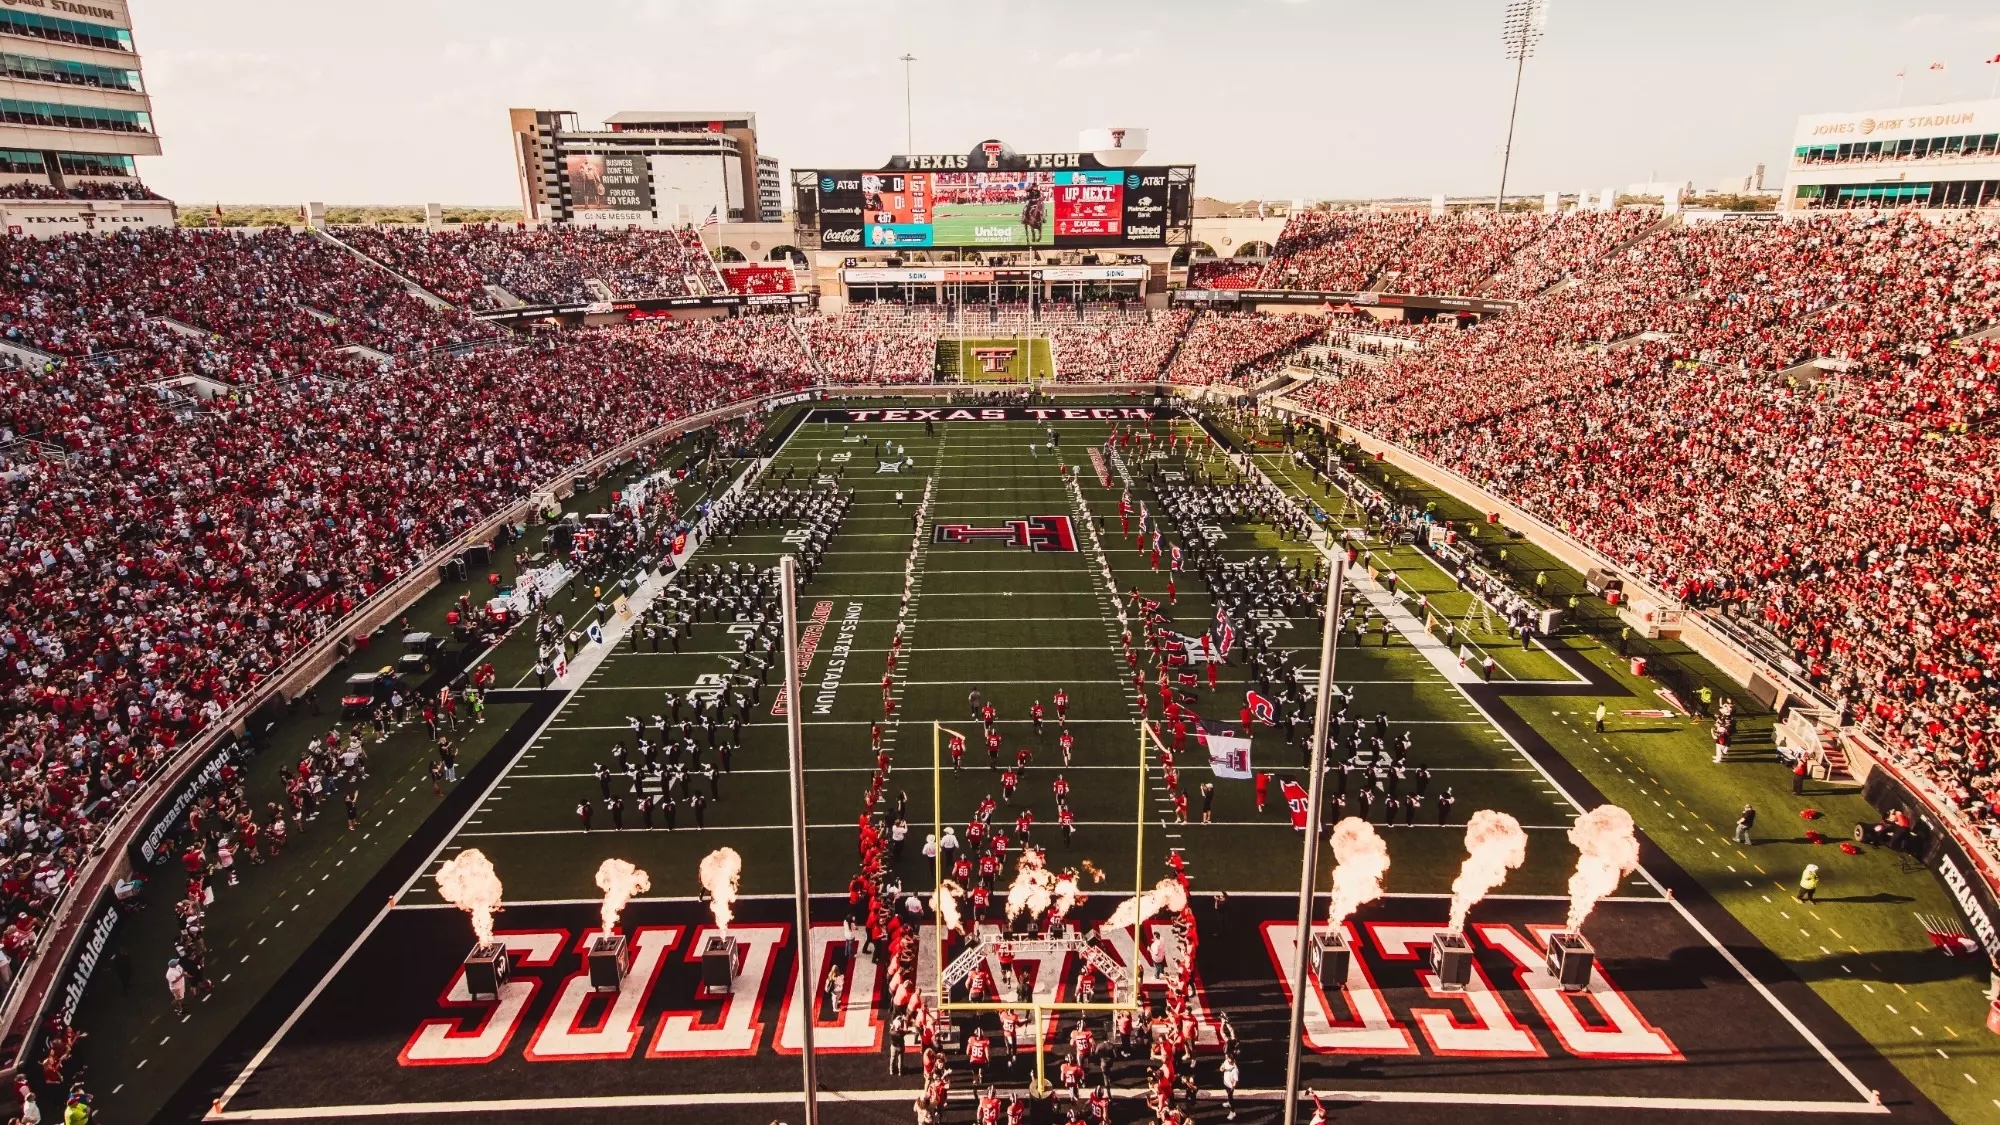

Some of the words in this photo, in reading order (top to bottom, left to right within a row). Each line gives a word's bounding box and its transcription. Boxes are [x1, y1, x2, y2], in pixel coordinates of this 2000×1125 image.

[51, 0, 115, 20] STADIUM
[1812, 122, 1855, 136] JONES
[1876, 119, 1904, 131] AT&T
[1908, 112, 1975, 129] STADIUM
[605, 159, 633, 167] BUSINESS
[906, 155, 969, 170] TEXAS
[1026, 153, 1081, 168] TECH
[606, 167, 622, 175] DONE
[622, 167, 634, 175] THE
[602, 175, 623, 184] RIGHT
[624, 175, 640, 184] WAY
[1141, 176, 1166, 186] AT&T
[836, 180, 860, 190] AT&T
[1064, 187, 1080, 200] UP
[1082, 186, 1113, 200] NEXT
[607, 197, 617, 205] 50
[617, 196, 641, 205] YEARS
[974, 227, 1013, 237] United
[1127, 225, 1161, 235] United
[822, 228, 863, 243] Coca-Cola
[846, 257, 857, 267] 25
[1132, 256, 1142, 264] 25
[908, 272, 927, 280] SIDING
[1106, 270, 1125, 278] SIDING
[848, 408, 1005, 421] TEXAS
[1025, 408, 1149, 420] TECH
[811, 600, 834, 627] CODY
[839, 602, 864, 632] JONES
[831, 632, 855, 658] AT&T
[811, 660, 847, 715] STADIUM
[974, 896, 984, 905] 92
[1258, 918, 1688, 1062] RED
[1076, 1040, 1089, 1050] 66
[971, 1046, 984, 1058] 96
